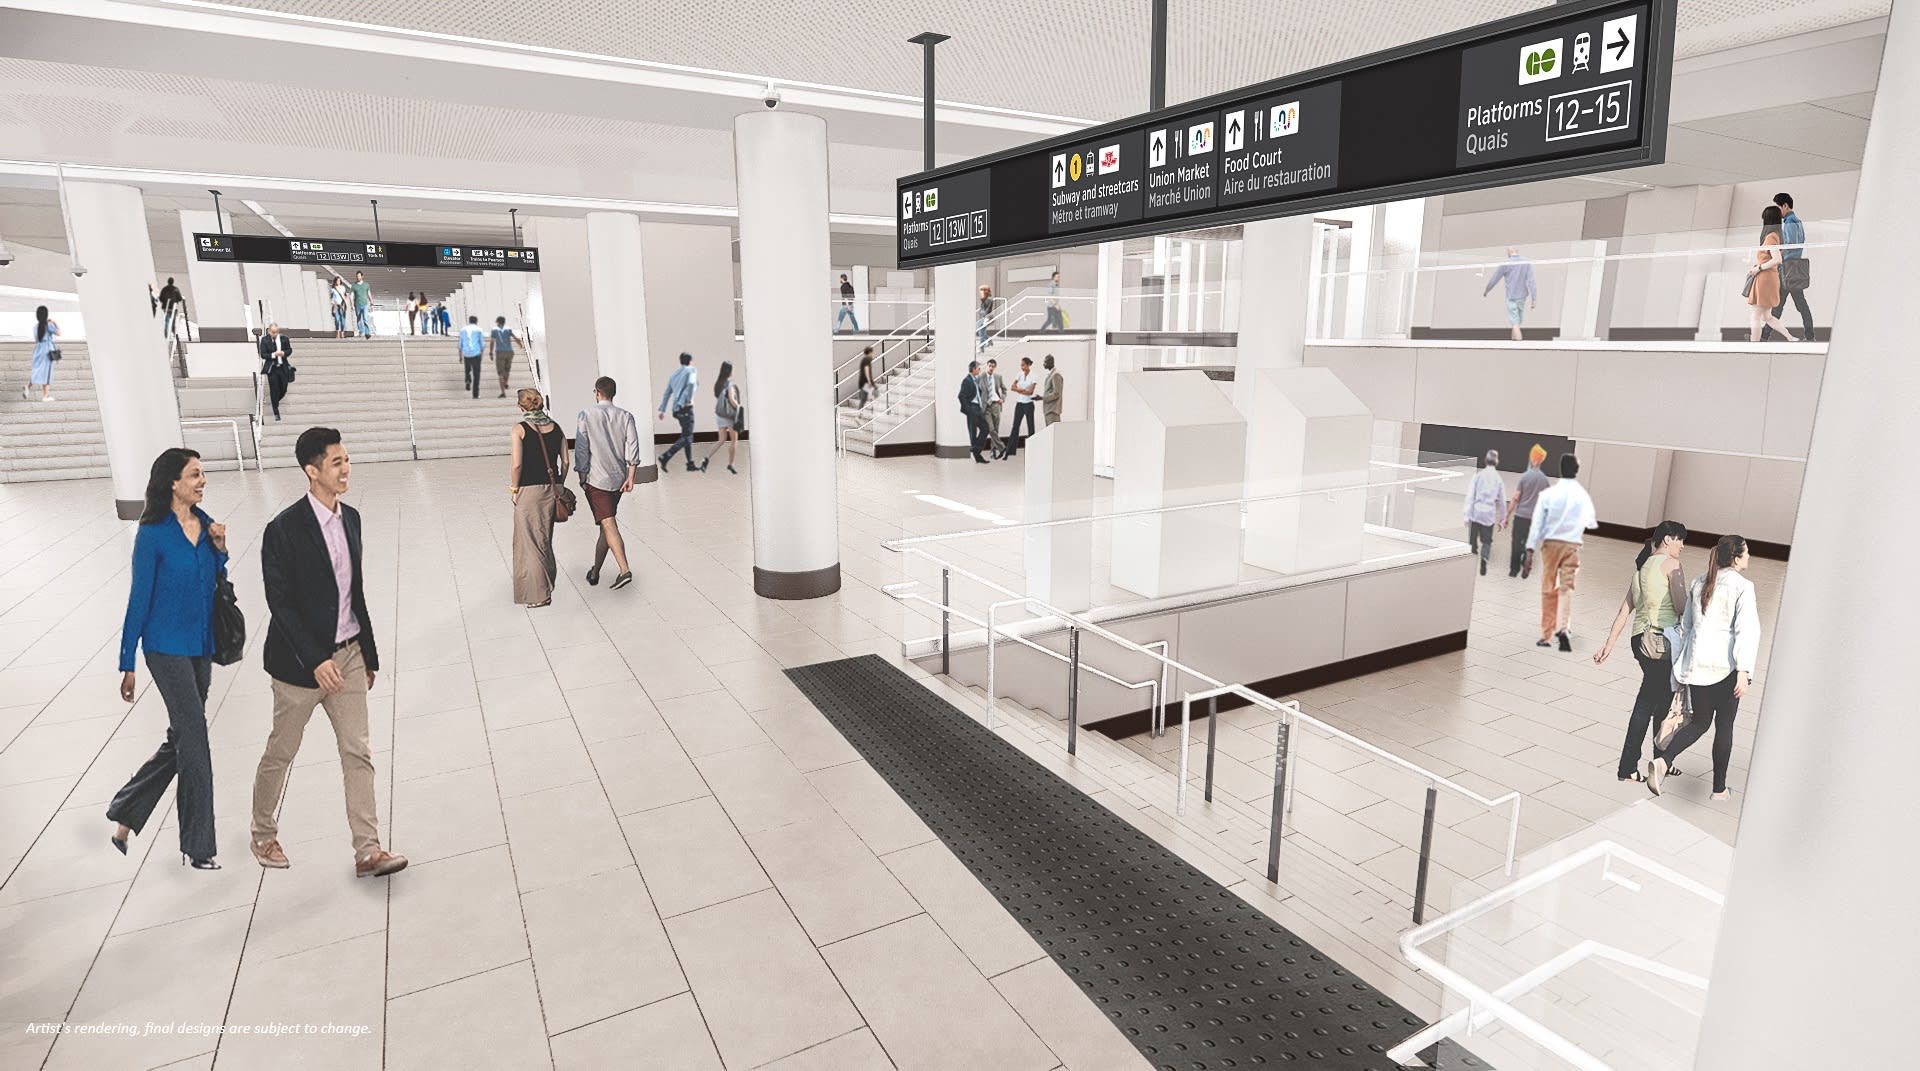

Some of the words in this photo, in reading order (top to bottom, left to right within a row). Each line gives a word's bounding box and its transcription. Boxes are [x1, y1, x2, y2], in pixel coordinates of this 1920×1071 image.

[1467, 98, 1543, 127] Platforms
[1555, 91, 1621, 131] 12-15
[1466, 129, 1508, 155] Quais
[1225, 153, 1250, 174] Food
[1252, 148, 1282, 168] Court
[1150, 170, 1175, 188] Union
[1177, 163, 1210, 182] Market
[1224, 178, 1245, 195] Aire
[1247, 174, 1260, 191] du
[1263, 163, 1331, 188] restauration
[1052, 191, 1080, 207] Subway
[1082, 184, 1097, 201] and
[1098, 179, 1139, 198] streetcars
[1149, 190, 1181, 208] Marché
[1183, 185, 1211, 202] Union
[1052, 209, 1073, 224] Métro
[1075, 206, 1083, 221] et
[1084, 202, 1119, 219] tramway
[903, 221, 929, 235] Platforms
[932, 223, 942, 241] 12
[948, 218, 966, 238] 13W
[973, 214, 984, 234] 15
[903, 237, 918, 250] Quais
